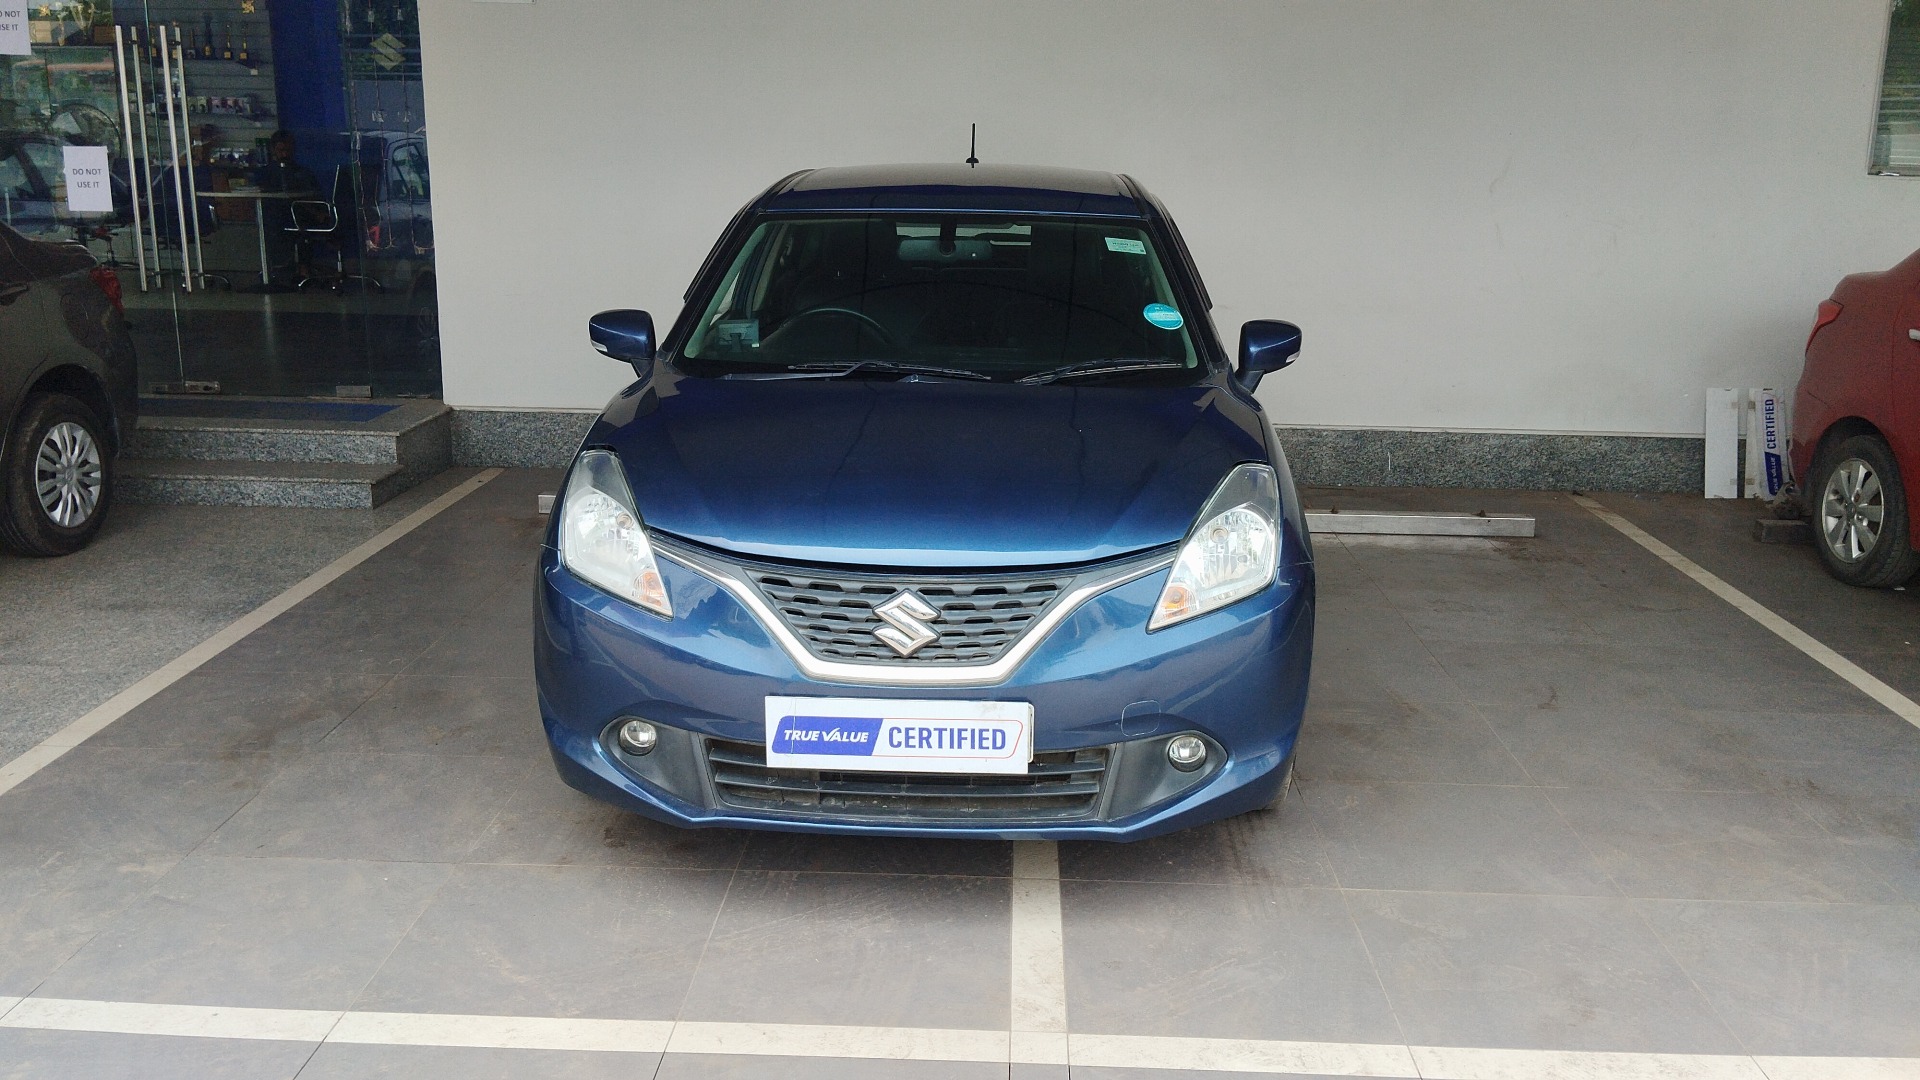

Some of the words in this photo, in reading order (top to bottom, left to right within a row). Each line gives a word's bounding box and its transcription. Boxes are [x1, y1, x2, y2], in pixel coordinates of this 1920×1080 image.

[1765, 399, 1776, 450] CERTIFIED
[783, 729, 820, 742] TRUE
[821, 727, 869, 743] VALUE
[888, 726, 1007, 751] CERTIFIED
